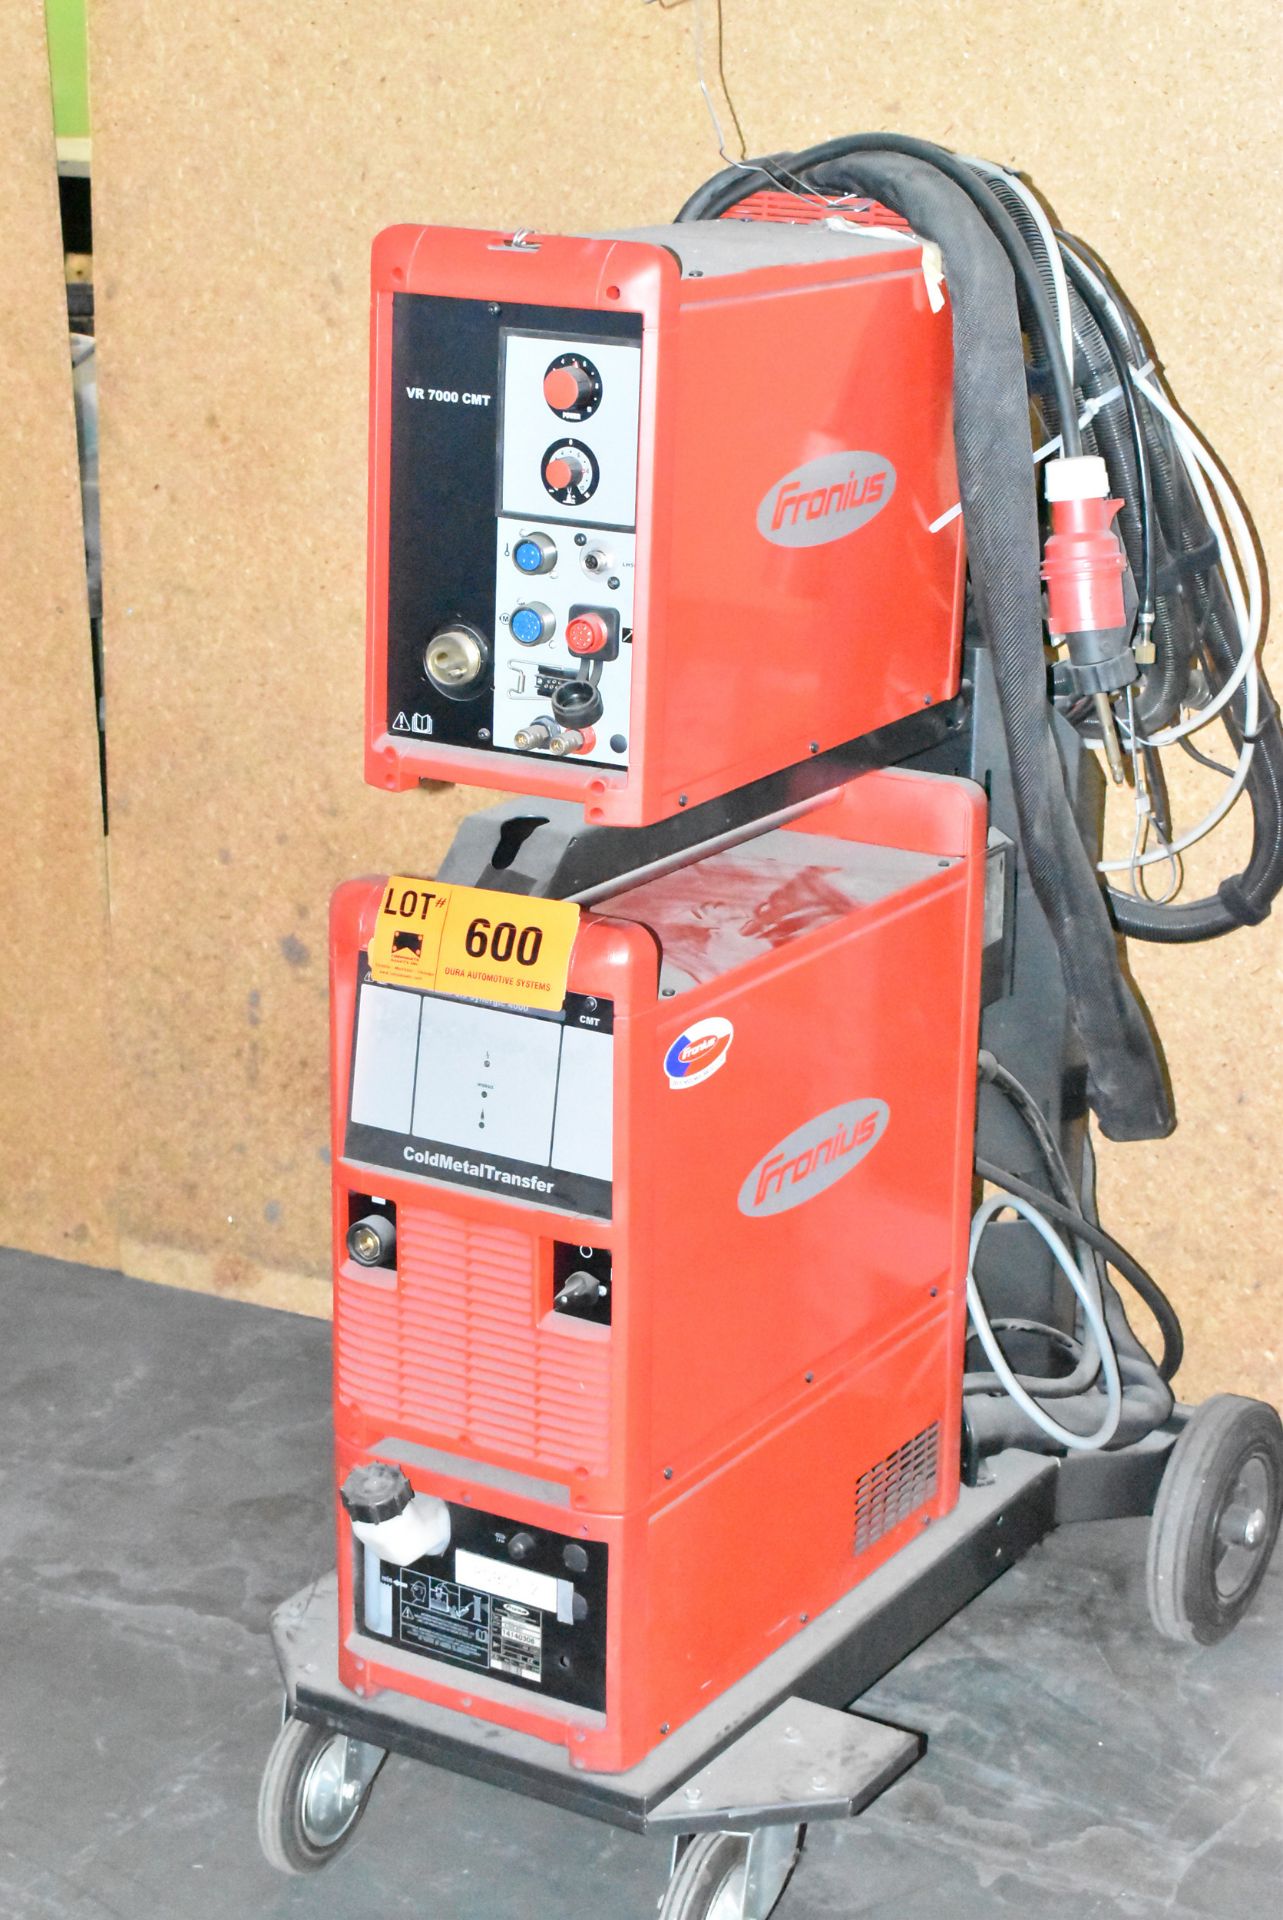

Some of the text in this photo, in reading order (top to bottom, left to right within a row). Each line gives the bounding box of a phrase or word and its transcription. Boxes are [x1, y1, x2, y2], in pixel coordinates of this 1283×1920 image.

[406, 387, 491, 406] VR 7000 CMT
[770, 470, 888, 532] Fronius
[465, 918, 543, 966] 600
[445, 966, 465, 977] DURA
[467, 972, 514, 985] AUTOMOTIVE
[516, 978, 551, 992] SYSTEMS
[579, 1015, 600, 1026] CMT
[403, 1146, 555, 1194] ColdMetalTransfer
[754, 1109, 880, 1206] Fronius
